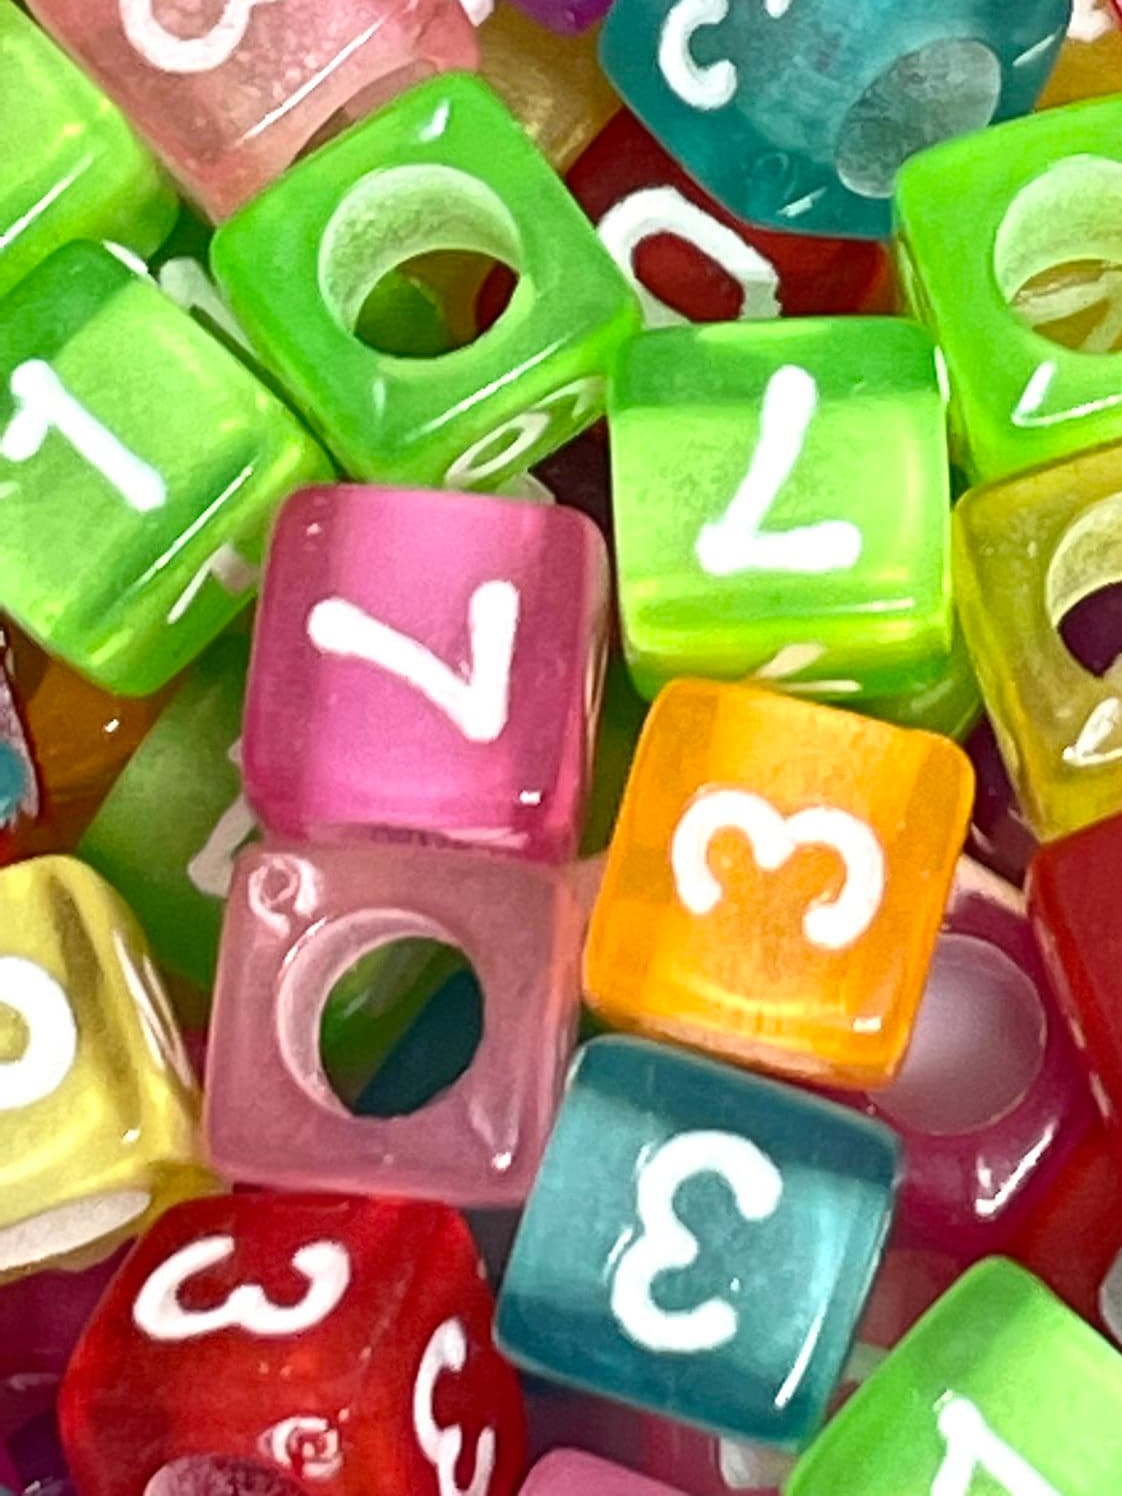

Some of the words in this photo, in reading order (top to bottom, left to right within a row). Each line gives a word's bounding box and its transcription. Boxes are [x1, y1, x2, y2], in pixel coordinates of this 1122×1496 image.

[0, 358, 166, 513] 1
[696, 365, 861, 576] 7
[308, 580, 520, 742] 7
[671, 787, 885, 950] 3
[132, 1234, 351, 1341] 3
[611, 1129, 783, 1353] 3
